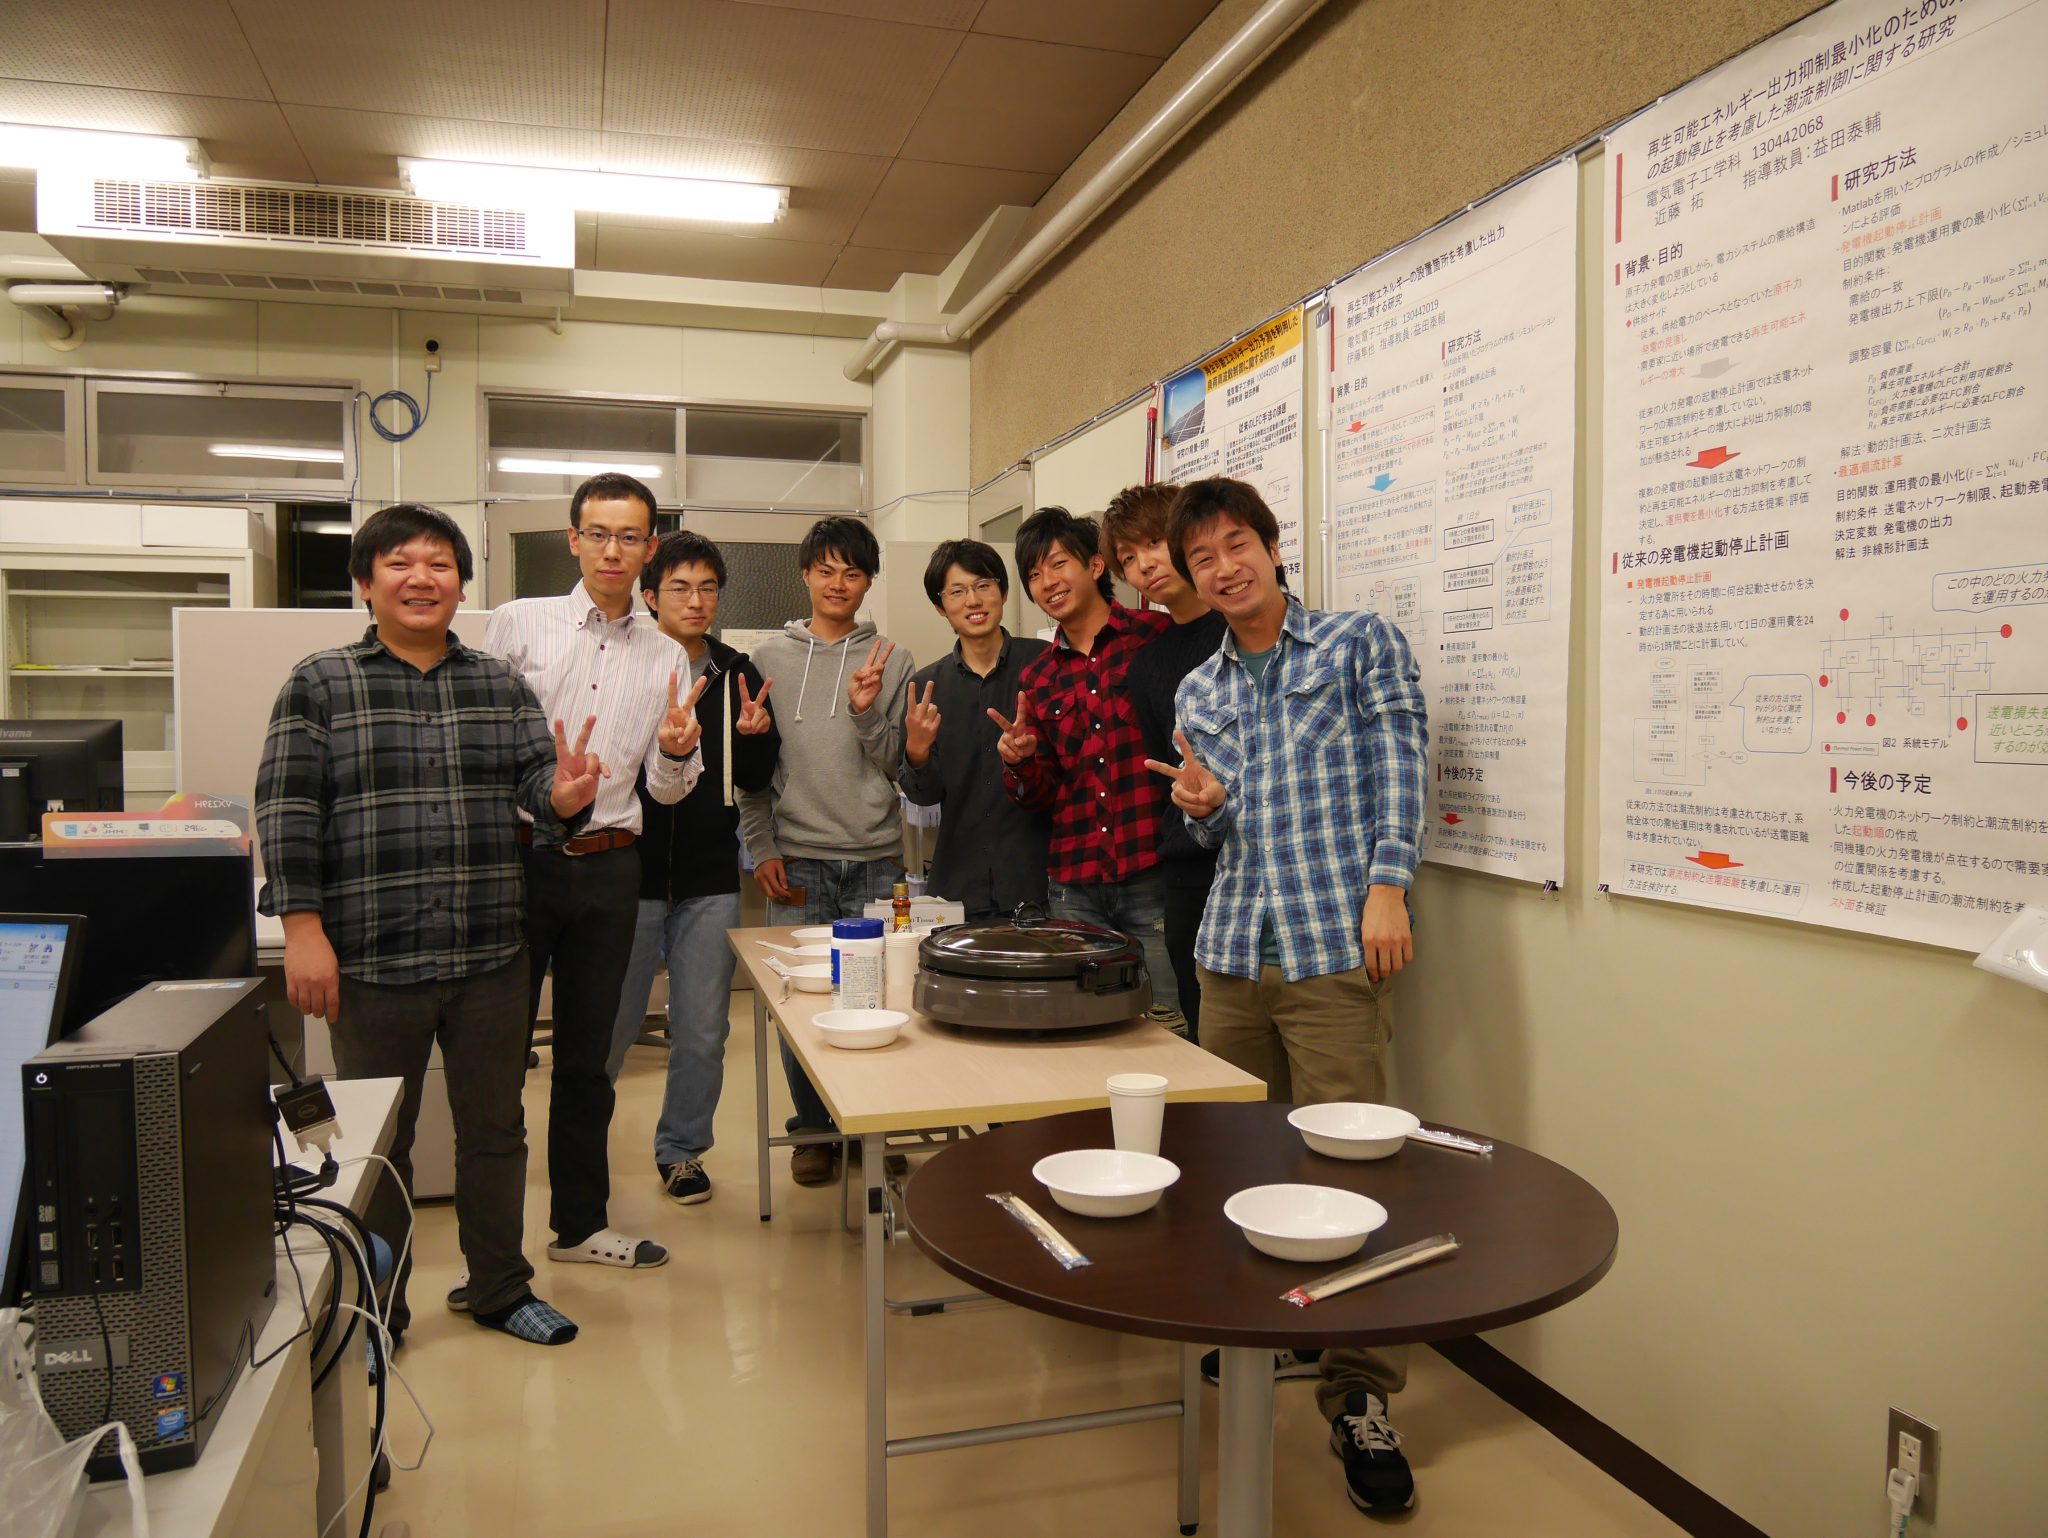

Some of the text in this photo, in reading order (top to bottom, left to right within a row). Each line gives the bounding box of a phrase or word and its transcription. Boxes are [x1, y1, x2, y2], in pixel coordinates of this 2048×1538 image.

[1648, 0, 1963, 159] 再生可能エネルギー出力抑制最小化のための
[1646, 115, 1824, 207] 電気電子工学科 130442068
[1844, 146, 1917, 191] 研究方法
[1654, 202, 1681, 227] 近藤
[1691, 192, 1704, 212] 拓
[1843, 203, 1902, 234] ンによる評価
[1849, 280, 1903, 307] 需給の一致
[1403, 299, 1439, 324] 130442019
[1447, 328, 1481, 353] 研究方法
[1622, 530, 1790, 570] 従来の発電機起動停止計画
[1443, 767, 1484, 782] 今後の予定
[1843, 770, 1932, 794] 今後の予定
[44, 1349, 93, 1366] DELL
